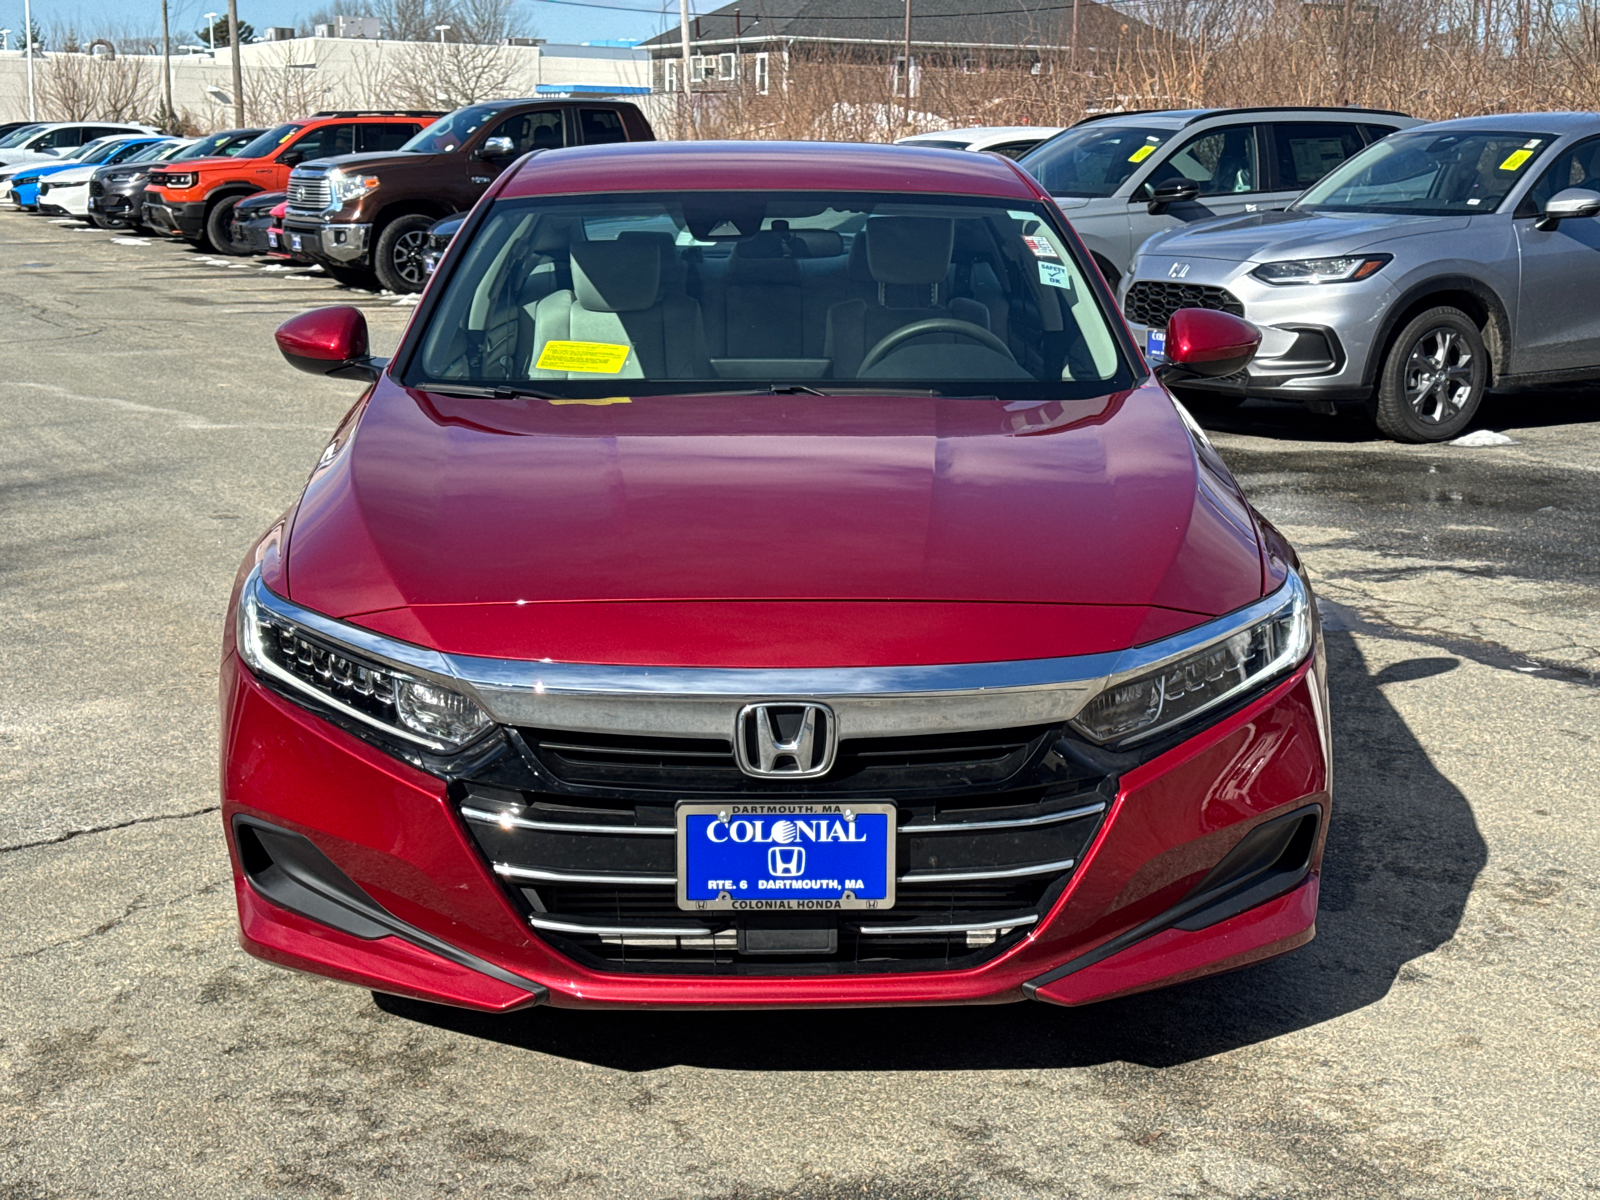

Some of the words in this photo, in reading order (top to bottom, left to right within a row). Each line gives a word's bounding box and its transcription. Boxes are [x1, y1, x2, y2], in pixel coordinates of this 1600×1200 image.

[1041, 264, 1065, 273] SAFETY
[822, 805, 841, 813] MA
[706, 819, 867, 844] COLONIAL
[708, 879, 737, 890] RTE.
[739, 880, 748, 889] 6
[758, 879, 841, 891] DARTMOUTH,
[844, 879, 864, 889] MA
[732, 900, 794, 909] COLONIAL
[797, 900, 841, 909] HONDA
